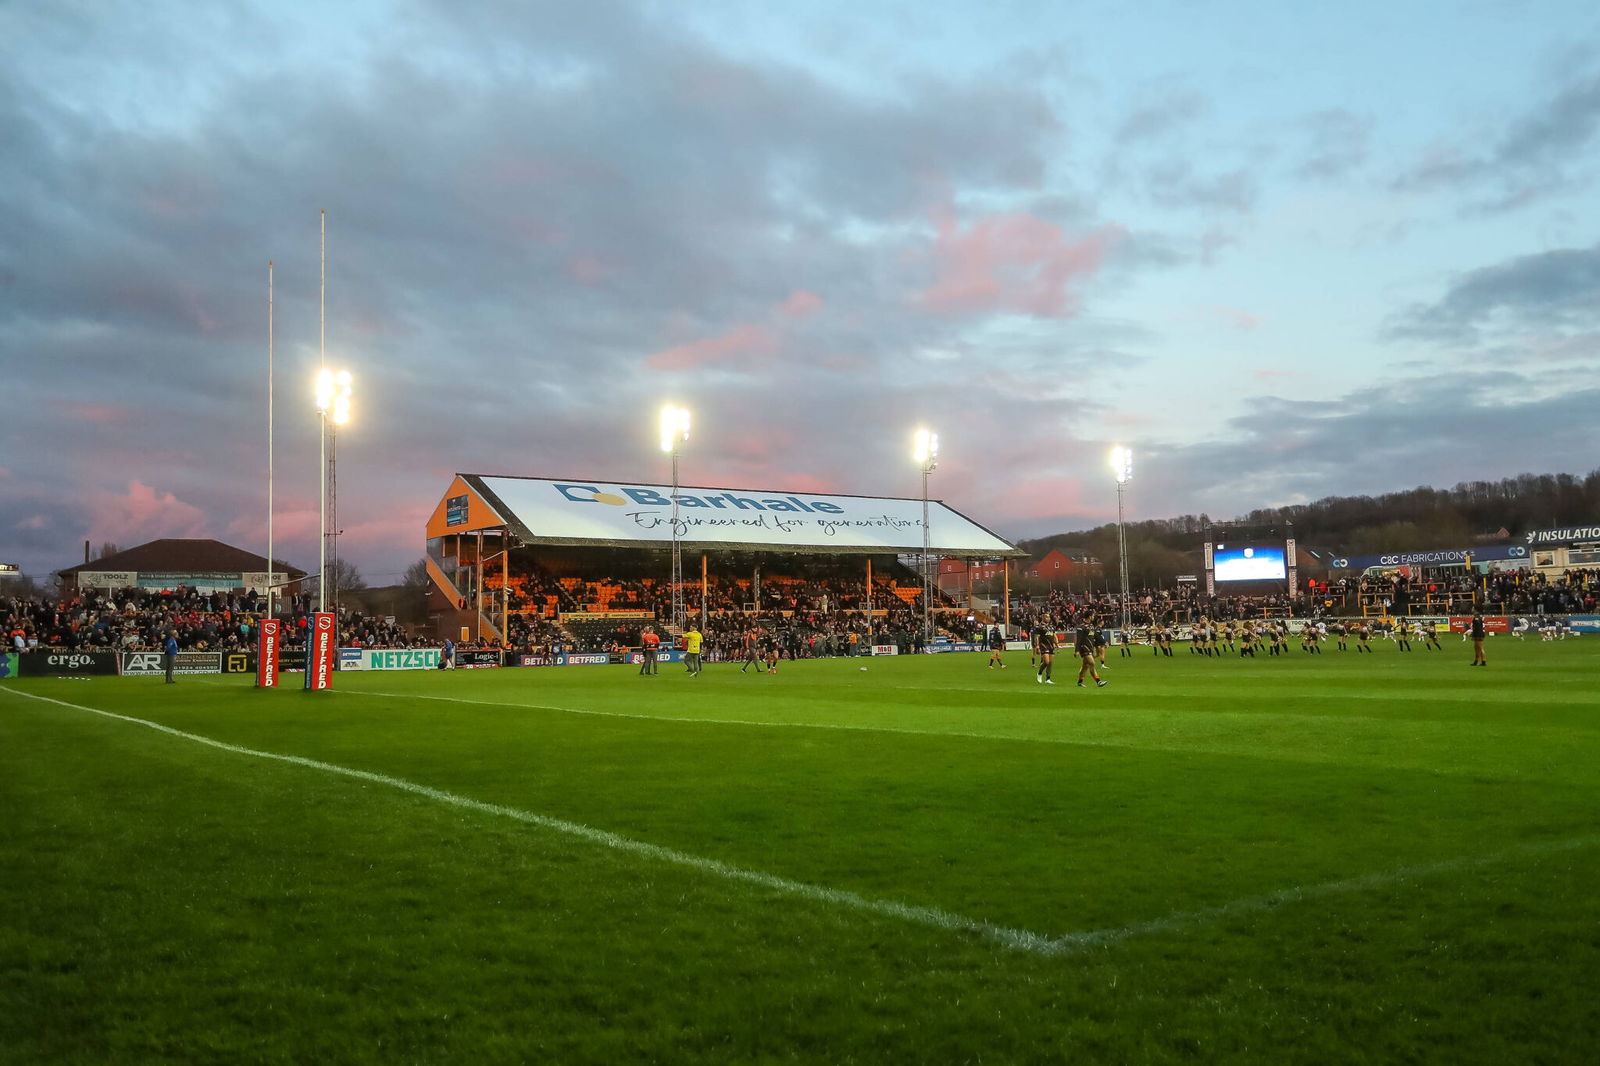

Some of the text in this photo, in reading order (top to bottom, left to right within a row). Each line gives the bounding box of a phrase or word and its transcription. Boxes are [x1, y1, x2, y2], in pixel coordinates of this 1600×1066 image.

[620, 487, 845, 514] Barhale
[625, 511, 771, 536] Engineered
[774, 515, 808, 533] for
[1380, 555, 1399, 565] C&C
[126, 654, 162, 670] AR
[265, 636, 274, 687] BETFRED
[318, 632, 329, 689] BETFRED
[568, 655, 606, 664] BETFRED
